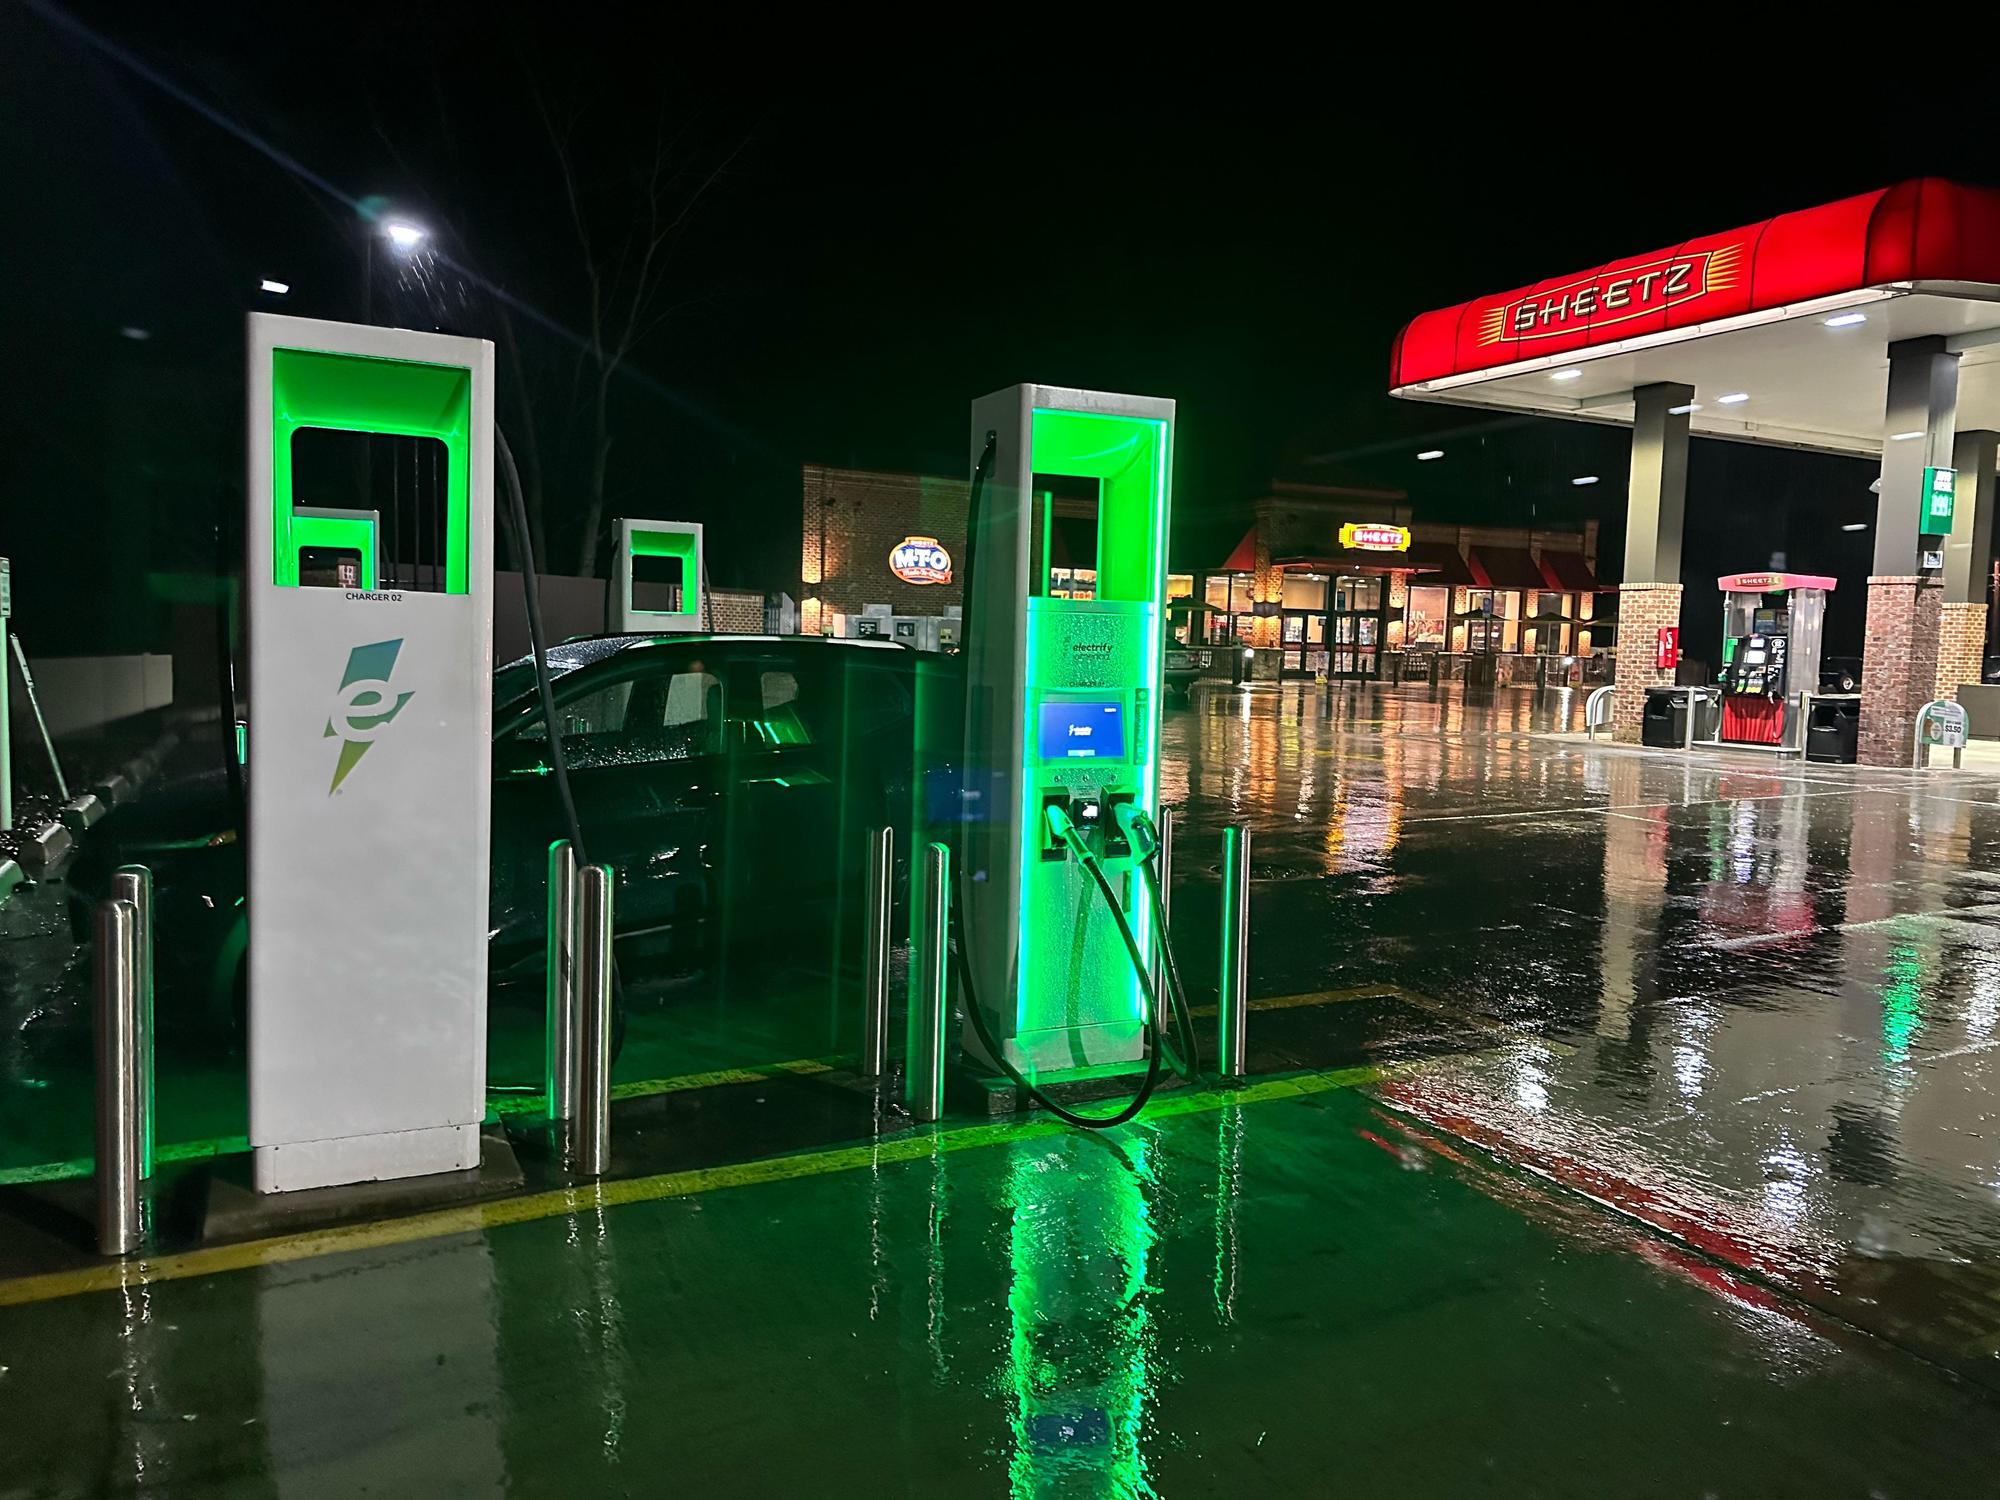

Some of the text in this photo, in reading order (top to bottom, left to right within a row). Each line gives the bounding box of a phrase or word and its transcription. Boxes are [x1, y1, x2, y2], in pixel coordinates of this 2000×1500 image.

[1514, 263, 1692, 331] SHEETZ
[345, 592, 403, 602] CHARGER 02
[1072, 643, 1113, 653] electrify
[1945, 724, 1962, 734] $3.50
